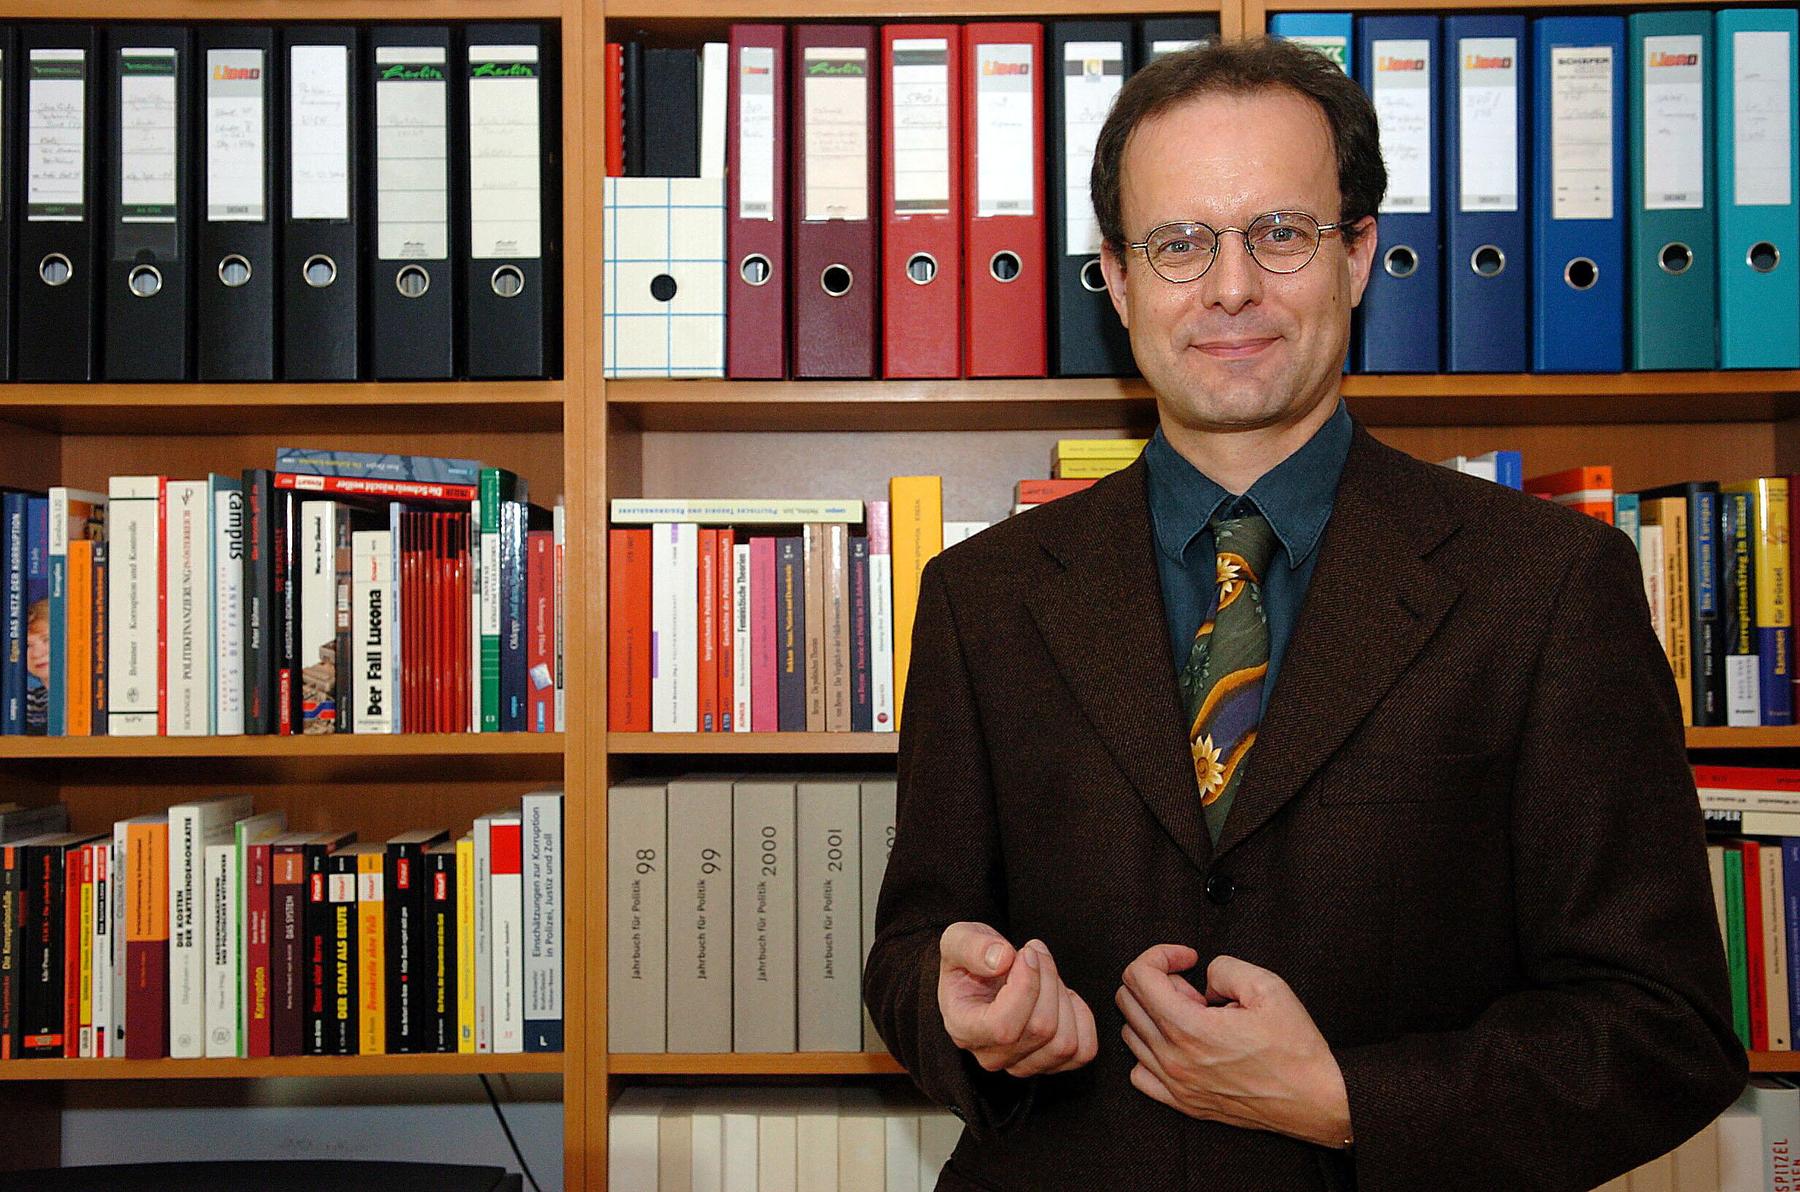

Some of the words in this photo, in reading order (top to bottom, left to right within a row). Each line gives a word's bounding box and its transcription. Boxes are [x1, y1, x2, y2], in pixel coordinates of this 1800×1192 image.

[10, 513, 20, 570] KORRUPTION
[224, 492, 242, 560] campus
[10, 573, 19, 591] DER
[367, 589, 382, 645] Lucona
[366, 652, 382, 680] Fall
[367, 686, 382, 716] Der
[530, 807, 542, 860] Korruption
[544, 833, 552, 853] Zoll
[544, 856, 552, 875] und
[636, 849, 656, 874] 98
[701, 848, 721, 874] 99
[761, 826, 776, 876] 2000
[827, 829, 842, 872] 2001
[544, 878, 553, 906] Justiz
[632, 880, 641, 911] Politik
[697, 880, 706, 911] Politik
[757, 881, 766, 913] Politik
[824, 880, 833, 911] Politik
[176, 890, 184, 928] KOSTEN
[336, 906, 348, 937] BEUTE
[530, 880, 542, 957] Einschätzungen
[632, 916, 641, 930] für
[697, 916, 706, 930] für
[757, 917, 766, 931] für
[824, 916, 833, 930] für
[285, 923, 295, 940] DAS
[544, 909, 554, 945] Polizei,
[3, 956, 11, 969] Die
[336, 940, 348, 961] ALS
[544, 948, 553, 957] in
[632, 934, 642, 979] Jahrbuch
[697, 934, 707, 979] Jahrbuch
[757, 935, 767, 981] Jahrbuch
[824, 934, 834, 979] Jahrbuch
[336, 962, 348, 995] STAAT
[336, 998, 348, 1019] DER
[1773, 1138, 1789, 1192] SPITZEL
